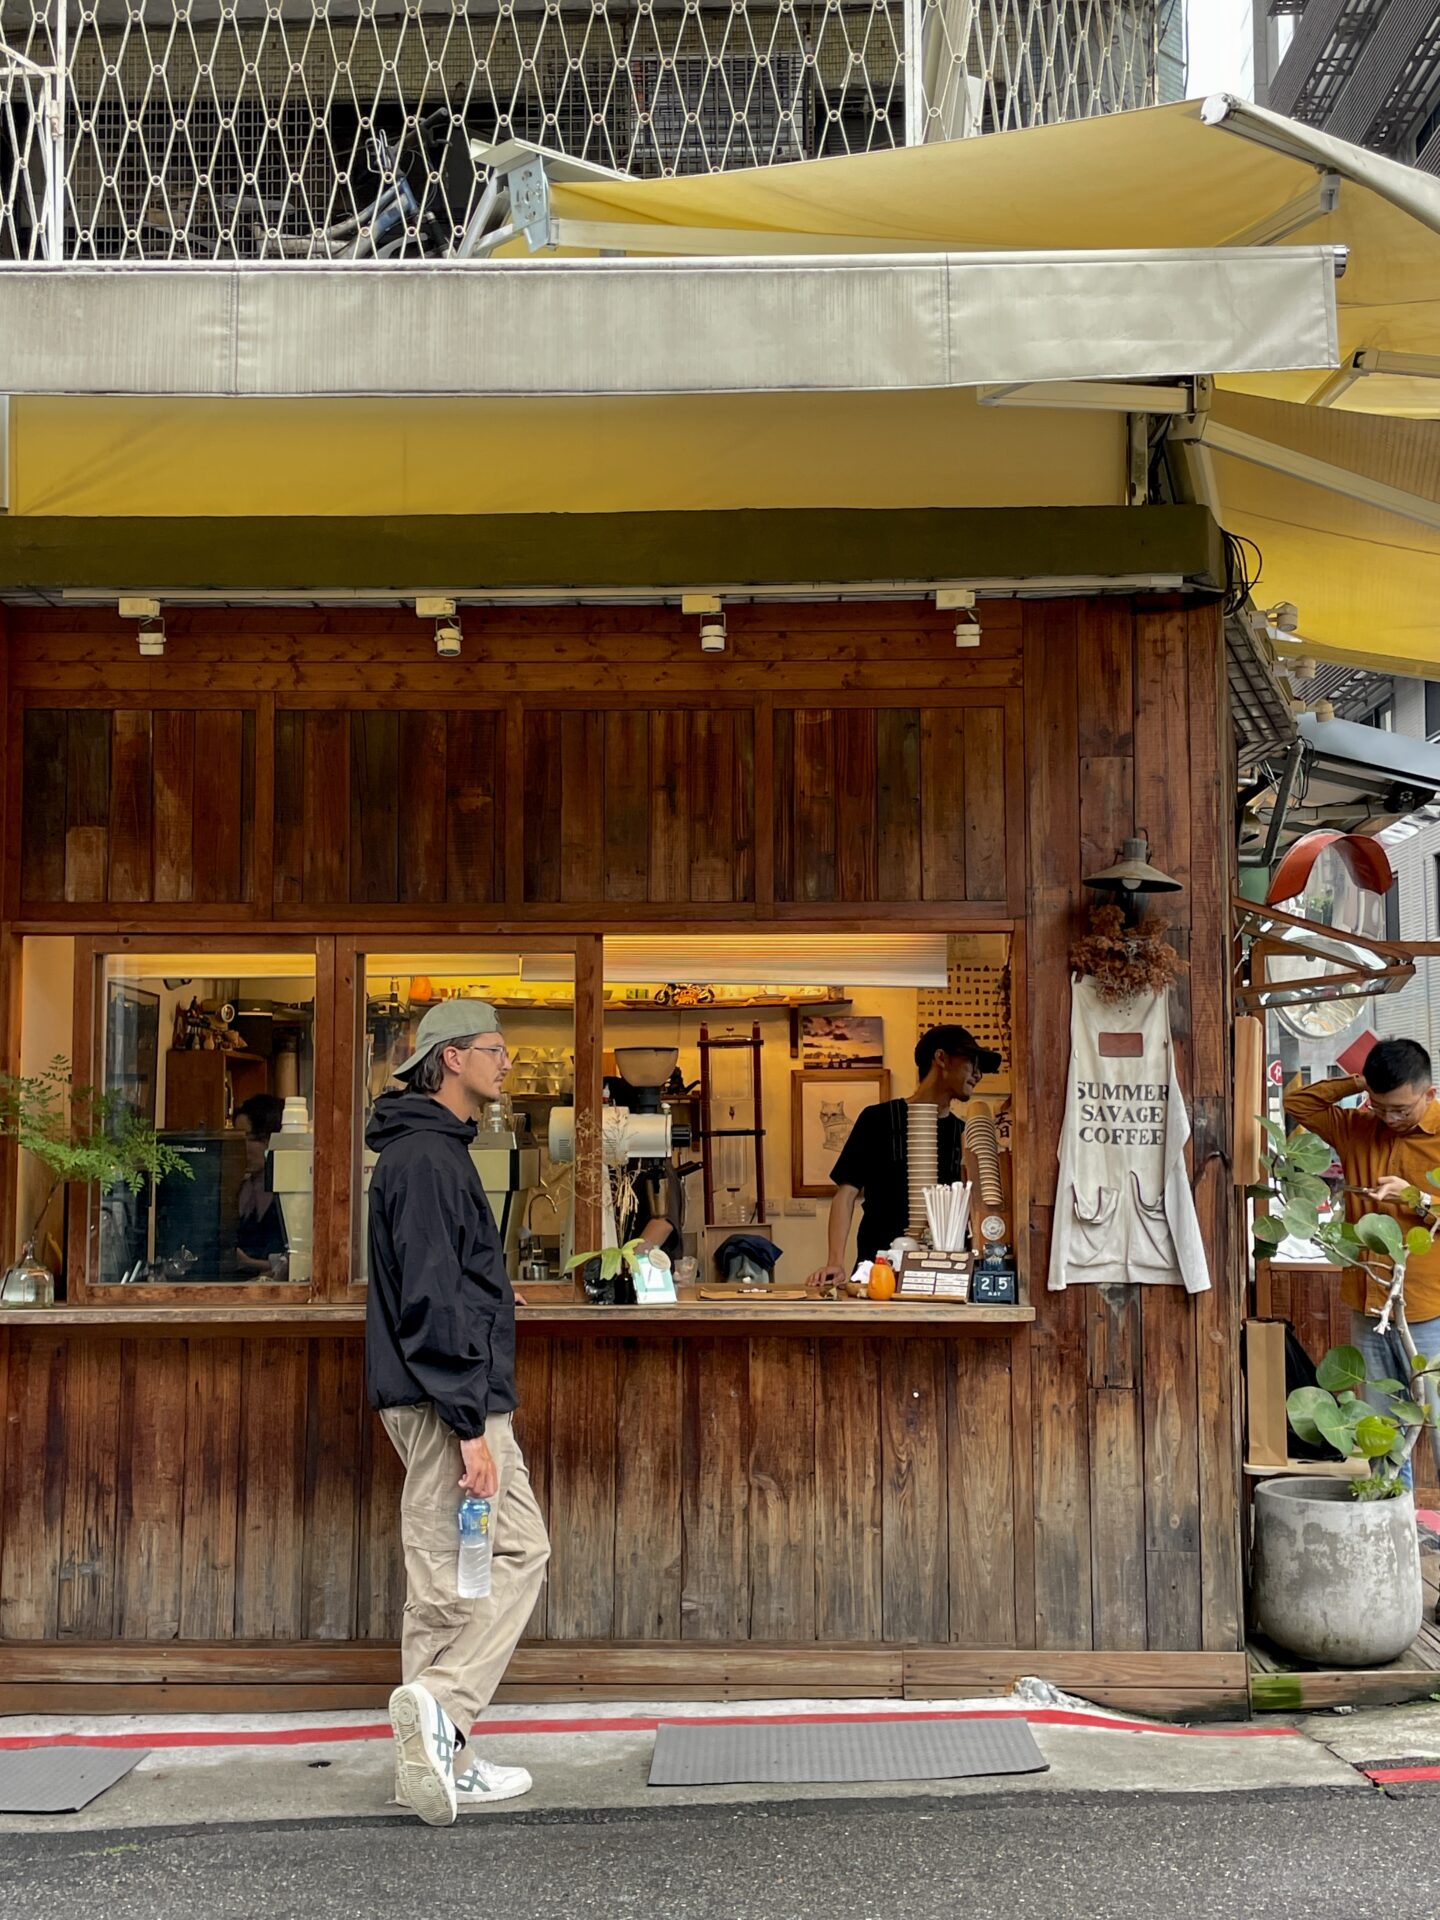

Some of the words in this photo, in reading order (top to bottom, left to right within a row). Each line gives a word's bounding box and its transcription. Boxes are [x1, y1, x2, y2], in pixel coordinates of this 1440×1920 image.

[1077, 1081, 1169, 1101] SUMMER
[1081, 1104, 1164, 1123] SAVAGE
[1079, 1126, 1165, 1145] COFFEE
